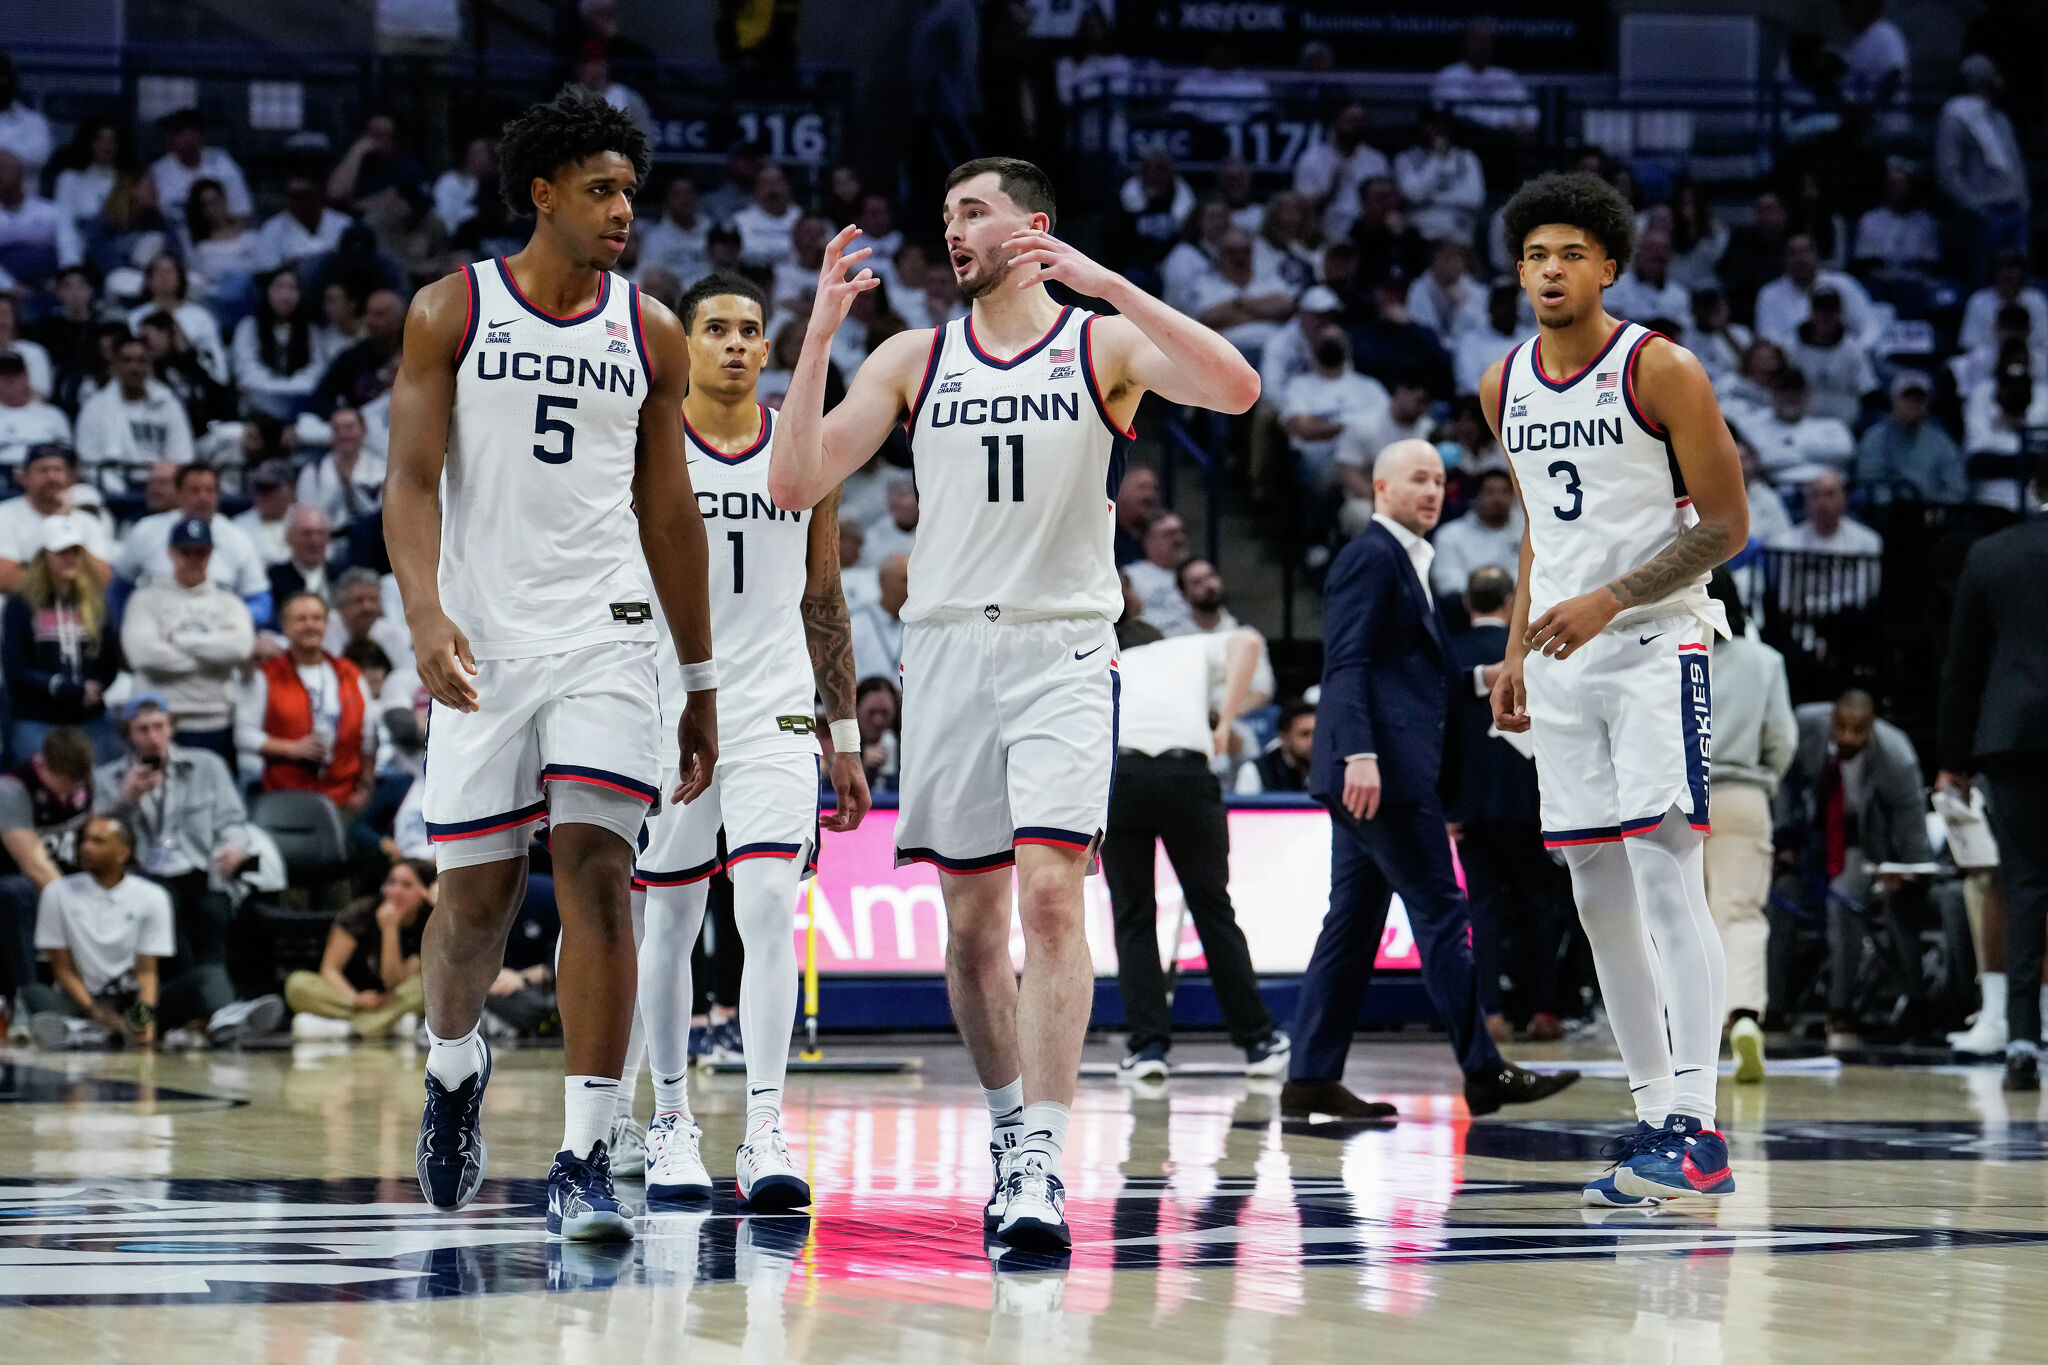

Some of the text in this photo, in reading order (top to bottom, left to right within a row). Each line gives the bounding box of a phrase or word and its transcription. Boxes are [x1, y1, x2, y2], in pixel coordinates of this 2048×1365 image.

[738, 112, 825, 161] 116
[608, 345, 632, 355] EAST
[478, 351, 635, 397] UCONN
[937, 386, 962, 394] CHANGE
[1050, 370, 1076, 378] EAST
[931, 392, 1079, 428] UCONN
[1509, 410, 1528, 418] CHANGE
[533, 394, 578, 465] 5
[1507, 417, 1624, 454] UCONN
[981, 434, 1025, 503] 11
[694, 491, 801, 523] CON
[1547, 460, 1584, 521] 3
[727, 531, 744, 594] 1
